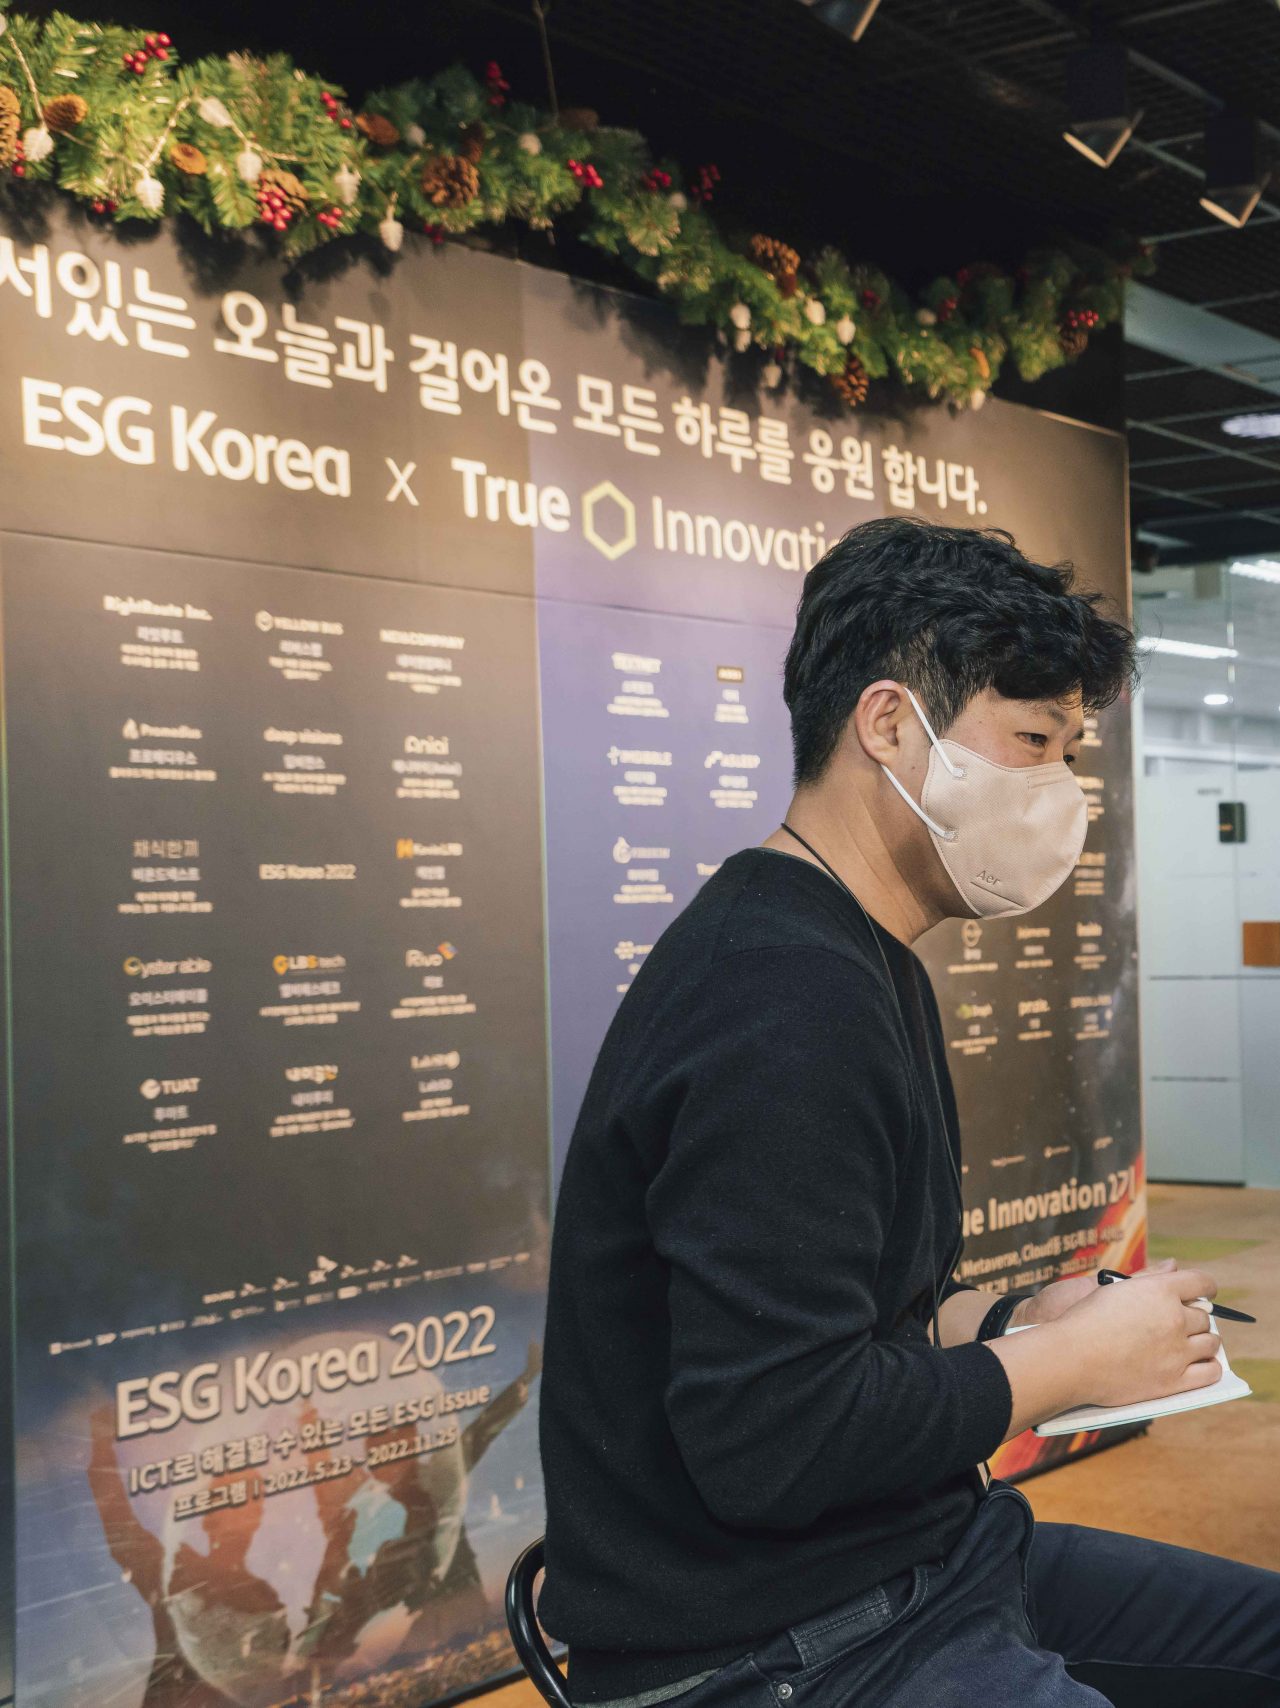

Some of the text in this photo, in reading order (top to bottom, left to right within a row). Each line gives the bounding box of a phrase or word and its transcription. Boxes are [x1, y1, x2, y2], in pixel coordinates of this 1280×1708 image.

[21, 376, 155, 465] ESG
[170, 404, 351, 498] Korea
[451, 456, 571, 532] True
[213, 290, 395, 393] 오늘과
[408, 333, 562, 434] 걸어온
[573, 373, 664, 456] 모든
[672, 394, 795, 485] 하루를
[803, 428, 875, 500] 응원
[881, 444, 988, 515] 합니다.
[976, 870, 1000, 885] Aer
[988, 1177, 1106, 1232] Innovation
[116, 1362, 221, 1440] ESG
[233, 1340, 379, 1412] Korea
[388, 1305, 497, 1378] 2022
[130, 1384, 491, 1495] ICT로 해결할 수 있는 모든 ESG Issue
[173, 1480, 247, 1520] 프로그램
[264, 1455, 353, 1498] 2022.5.23
[367, 1426, 458, 1469] 2022.11.25
